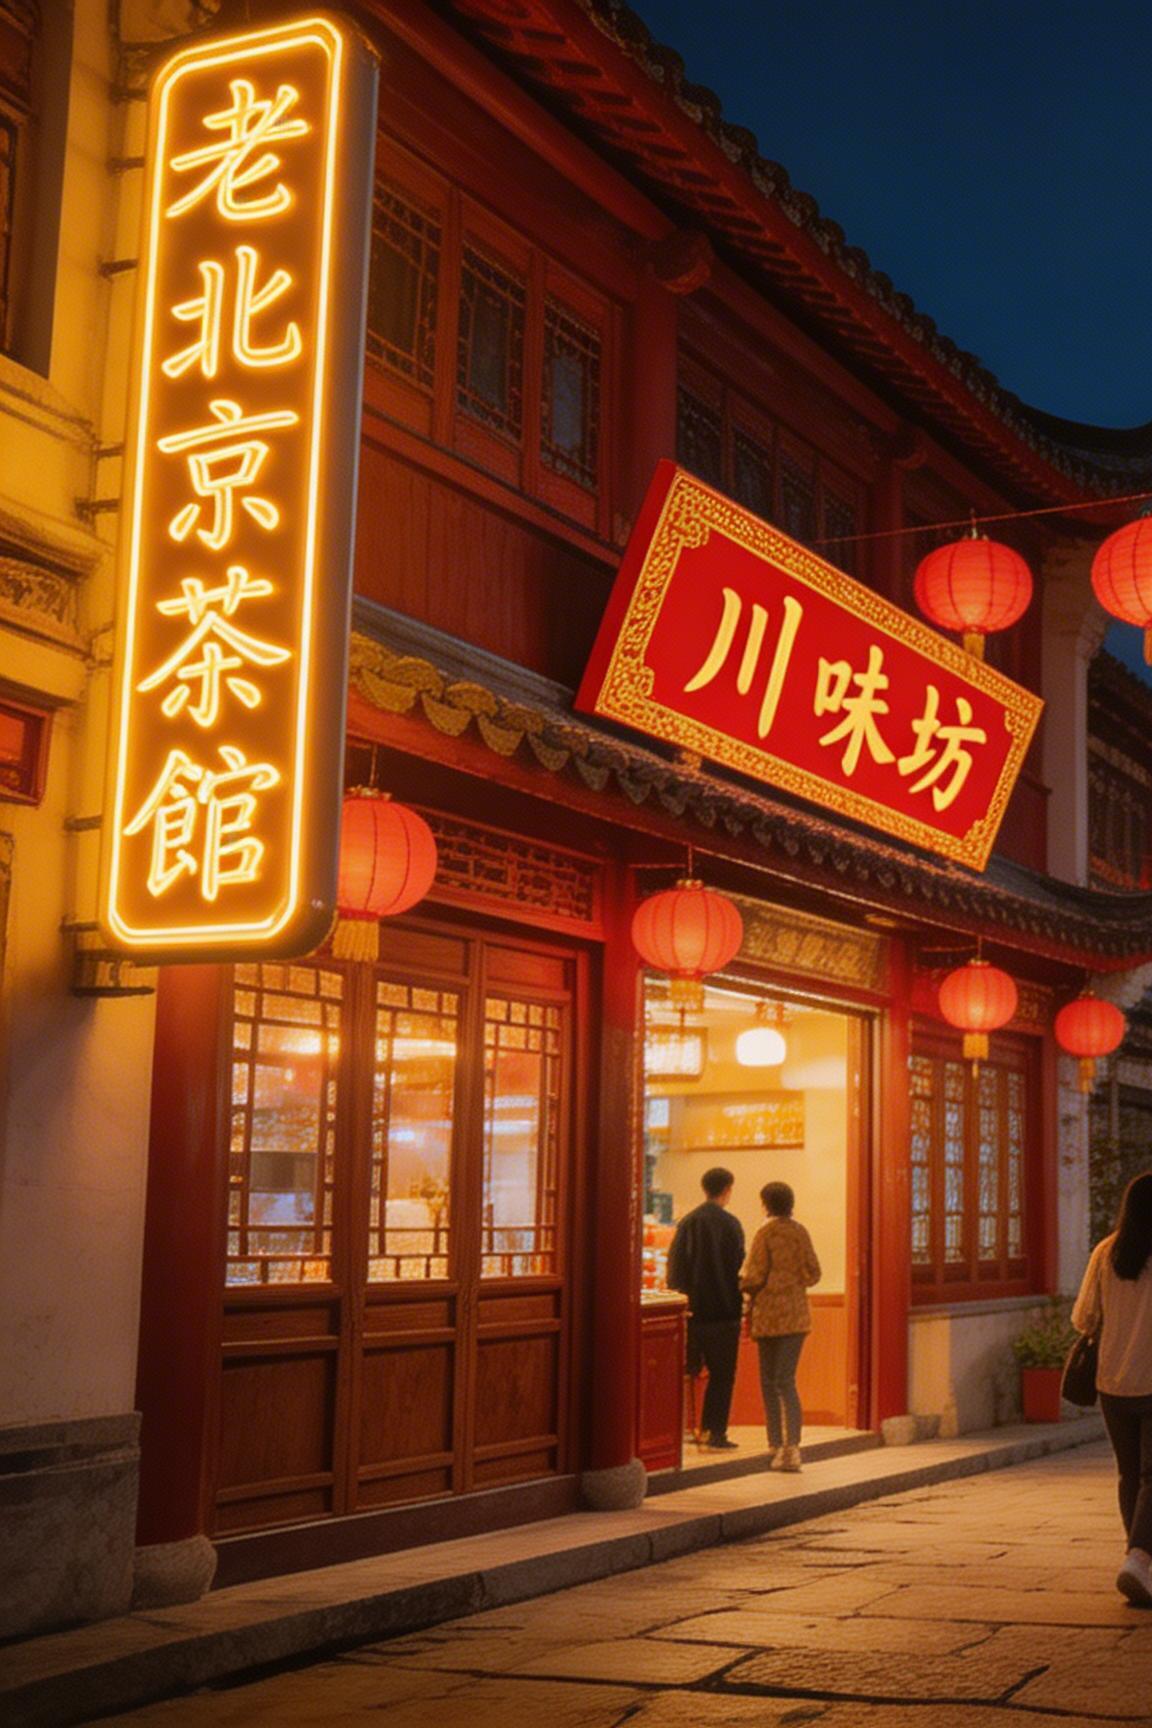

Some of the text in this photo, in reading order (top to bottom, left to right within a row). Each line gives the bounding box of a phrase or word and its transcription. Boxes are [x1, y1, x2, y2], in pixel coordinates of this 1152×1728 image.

[122, 79, 310, 901] 老北京茶館
[684, 587, 987, 812] 川味坊
